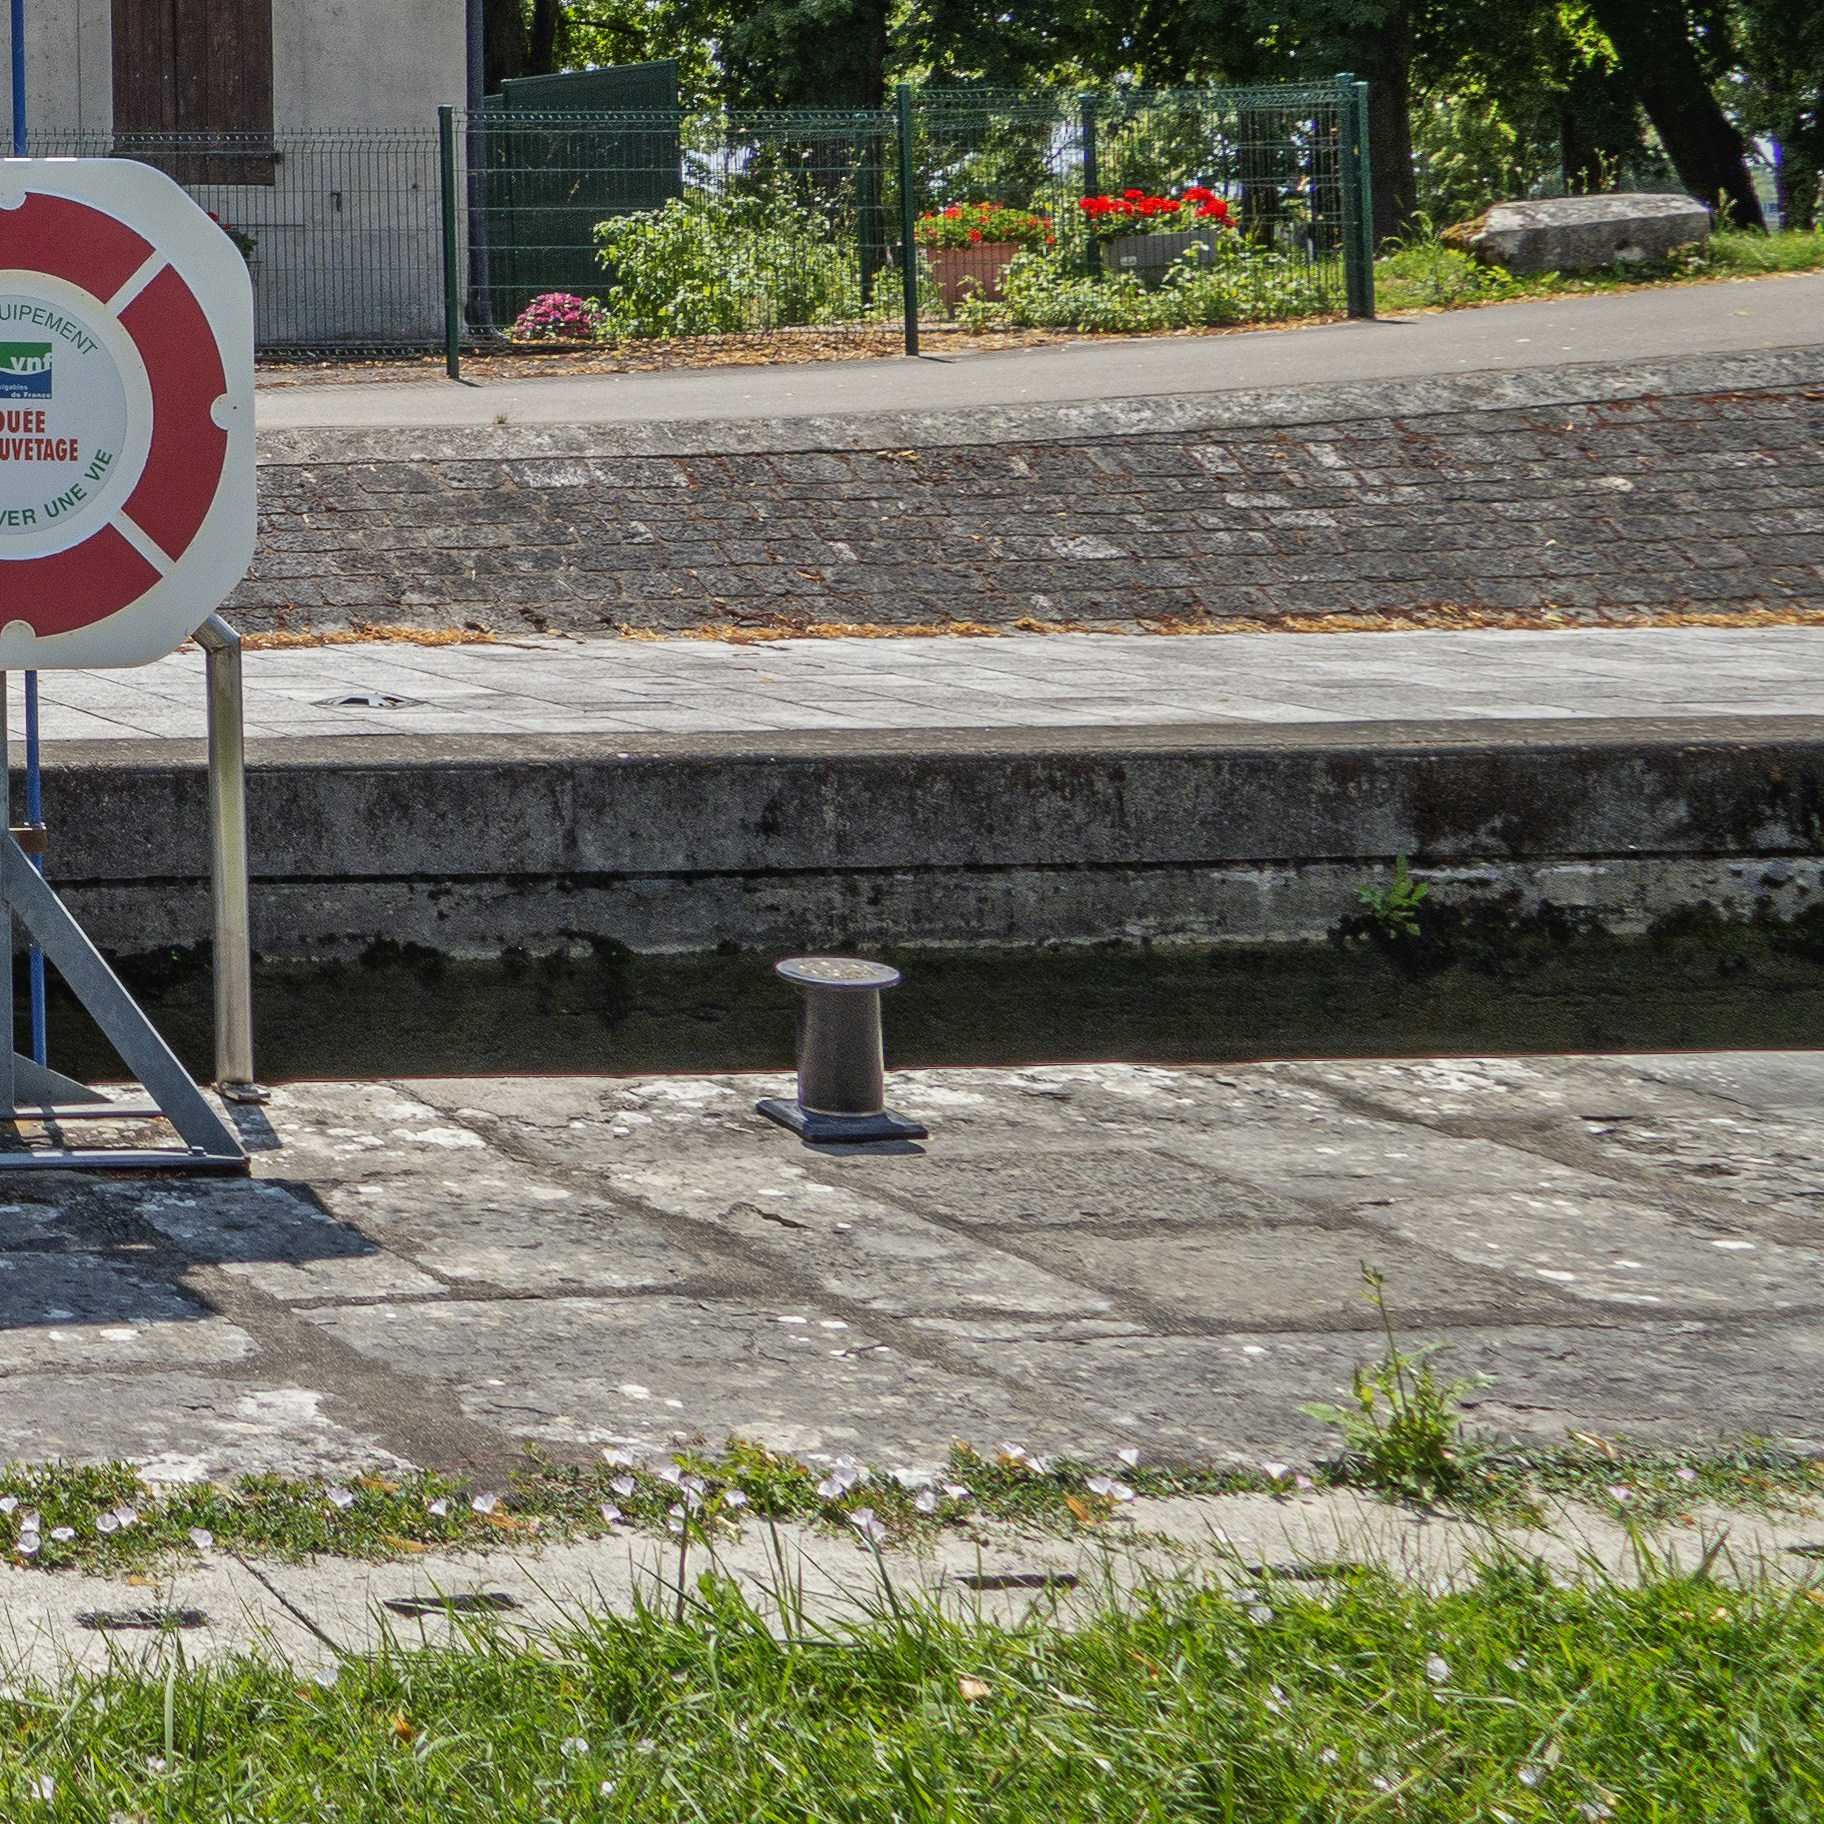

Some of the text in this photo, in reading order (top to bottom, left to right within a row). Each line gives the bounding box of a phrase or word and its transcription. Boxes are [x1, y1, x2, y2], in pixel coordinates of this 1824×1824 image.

[9, 352, 52, 372] vnf
[23, 391, 51, 399] France
[44, 483, 87, 520] UNE
[84, 448, 113, 485] VIE
